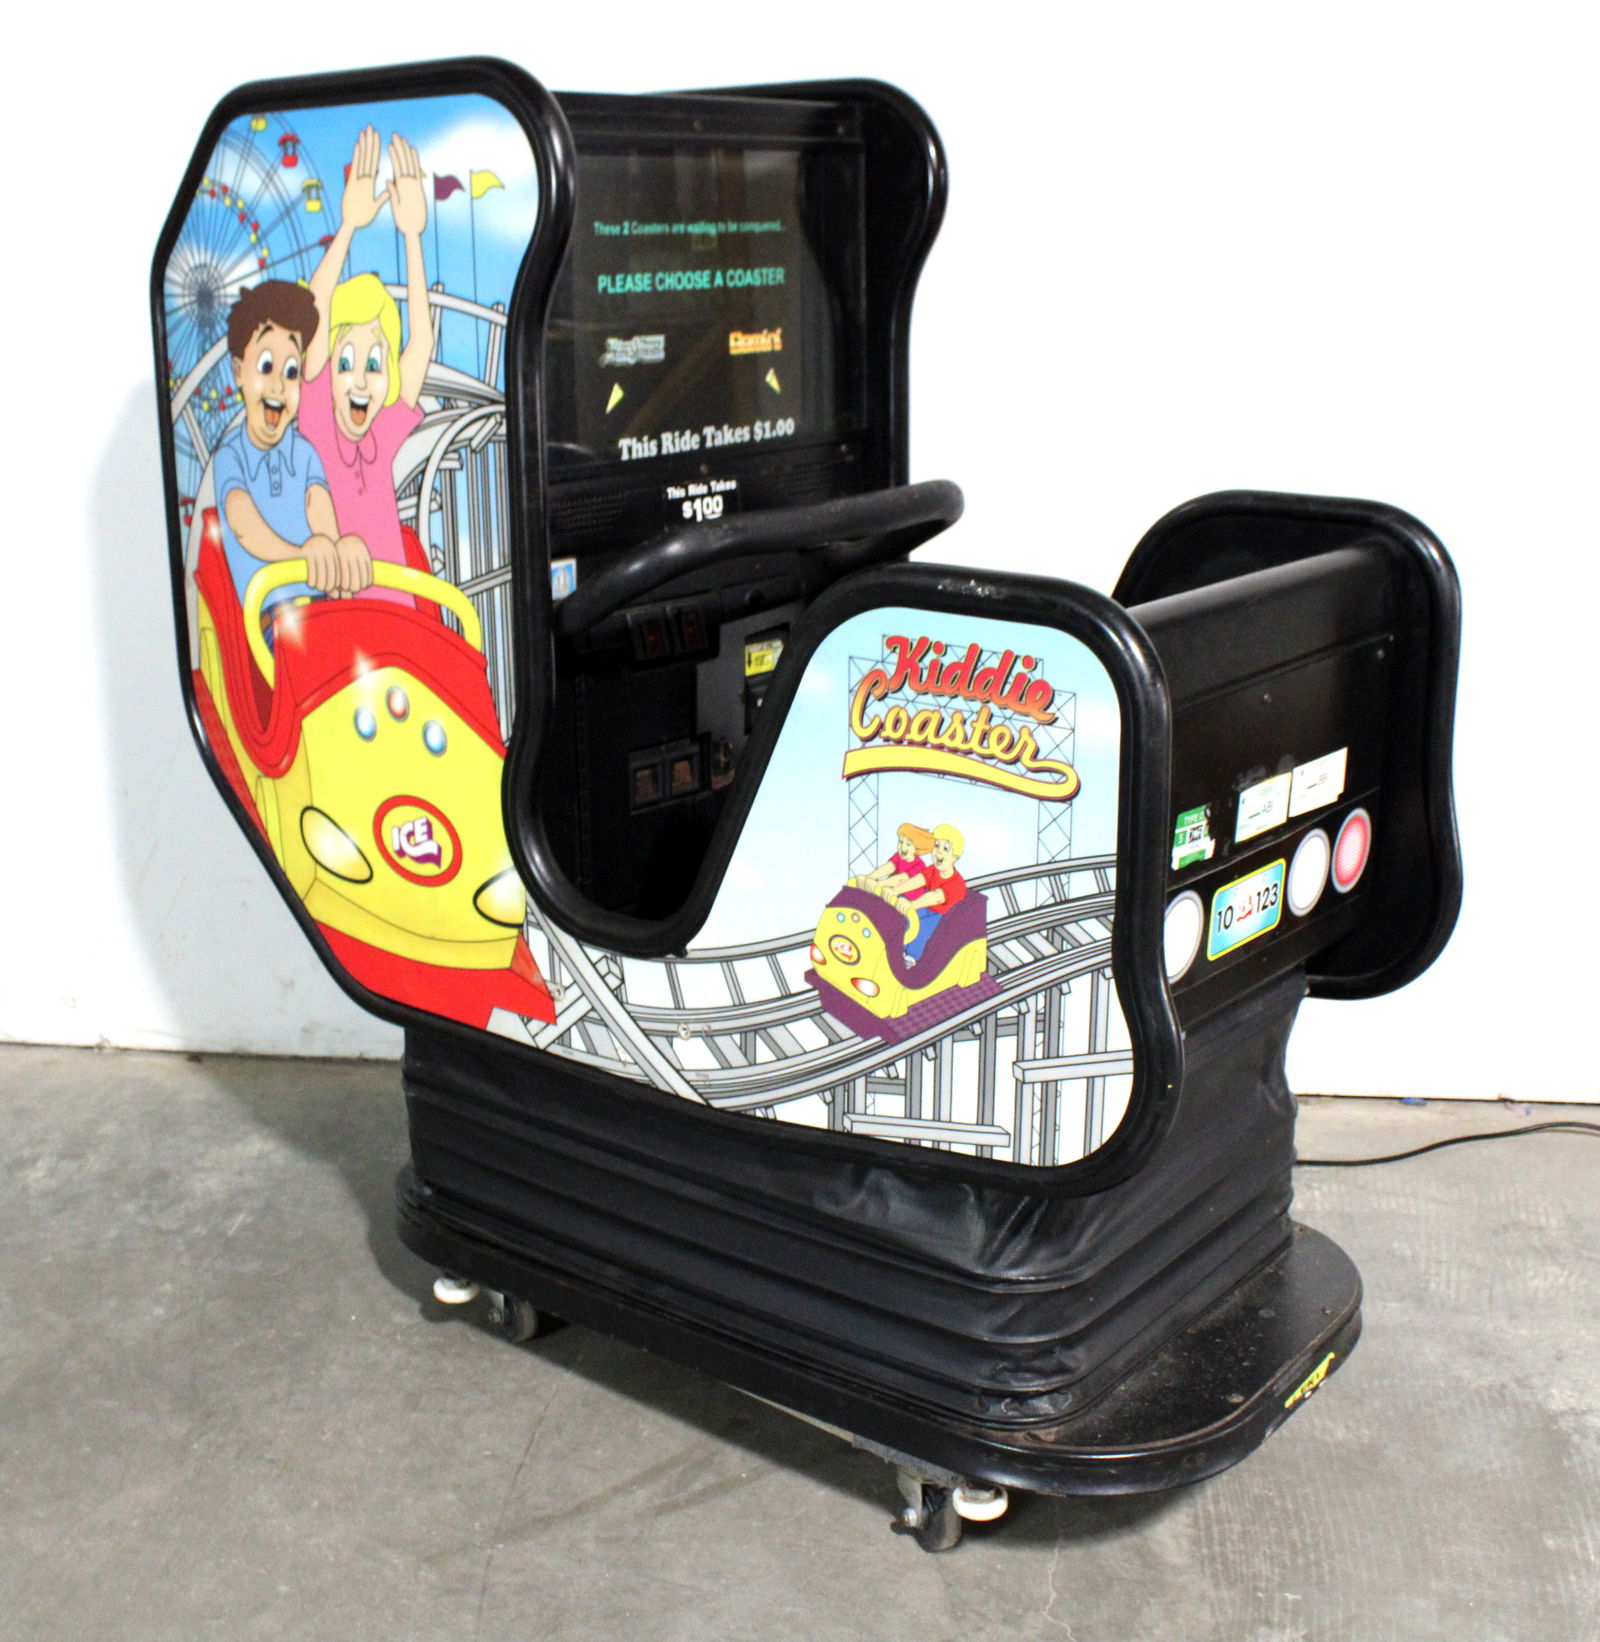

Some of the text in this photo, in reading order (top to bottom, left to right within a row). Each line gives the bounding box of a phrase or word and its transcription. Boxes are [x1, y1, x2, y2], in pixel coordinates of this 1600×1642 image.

[597, 266, 785, 294] PLEASE CHOOSE A COASTER
[618, 417, 795, 461] This Ride Takes $1.00
[666, 479, 737, 500] This Ride Takes
[885, 635, 1059, 725] Kiddie
[850, 667, 1058, 770] Coaster
[391, 815, 442, 869] ICE
[1217, 882, 1278, 933] 10 123
